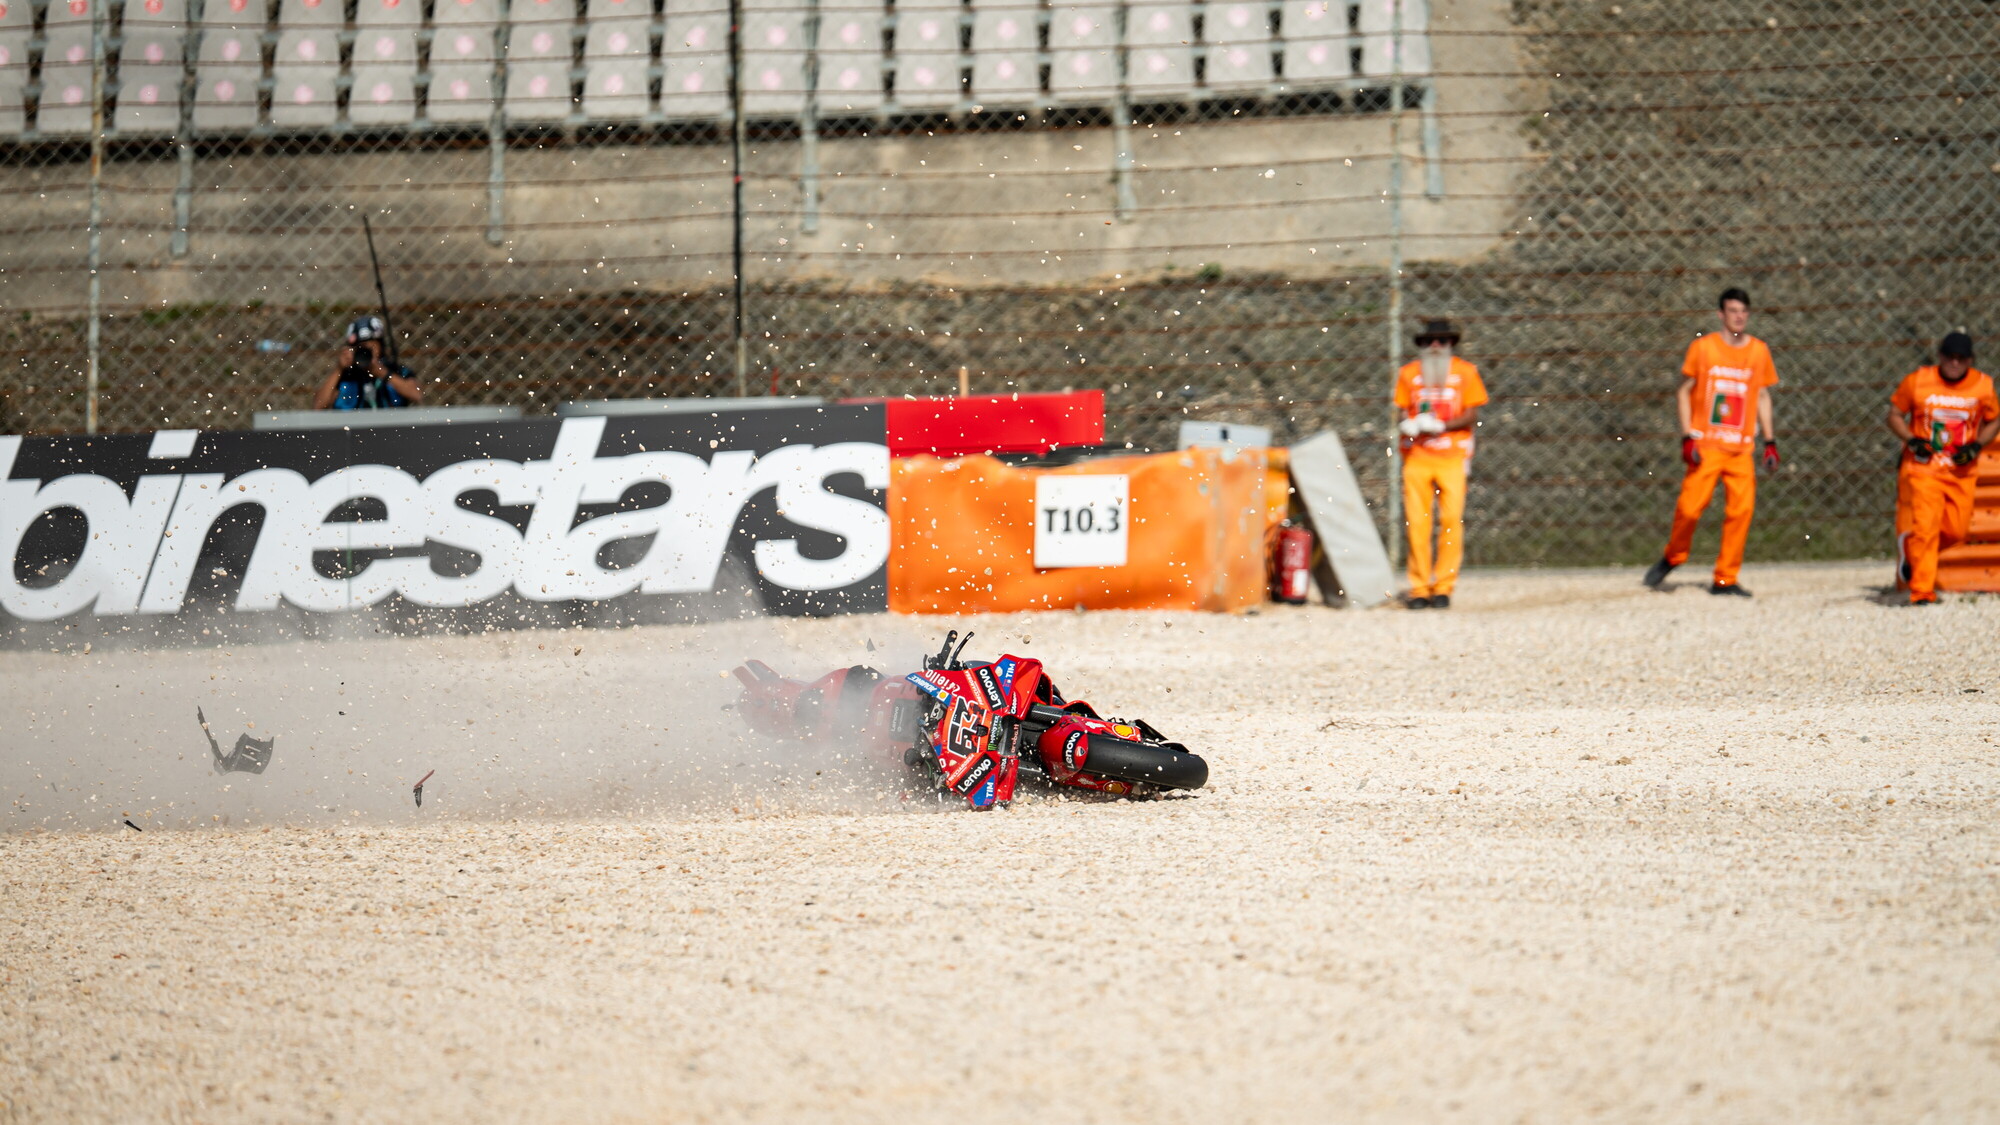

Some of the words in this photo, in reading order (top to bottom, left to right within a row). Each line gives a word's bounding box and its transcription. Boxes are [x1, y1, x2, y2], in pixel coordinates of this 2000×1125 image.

[0, 417, 888, 621] pinestars
[1043, 507, 1121, 533] T10.3
[1005, 663, 1016, 679] TIM
[979, 668, 1003, 709] Lenovo
[891, 706, 899, 732] Lenovo
[948, 696, 986, 758] 63
[1066, 732, 1081, 770] Lenovo
[957, 759, 991, 792] Lenovo
[986, 782, 994, 798] TIM
